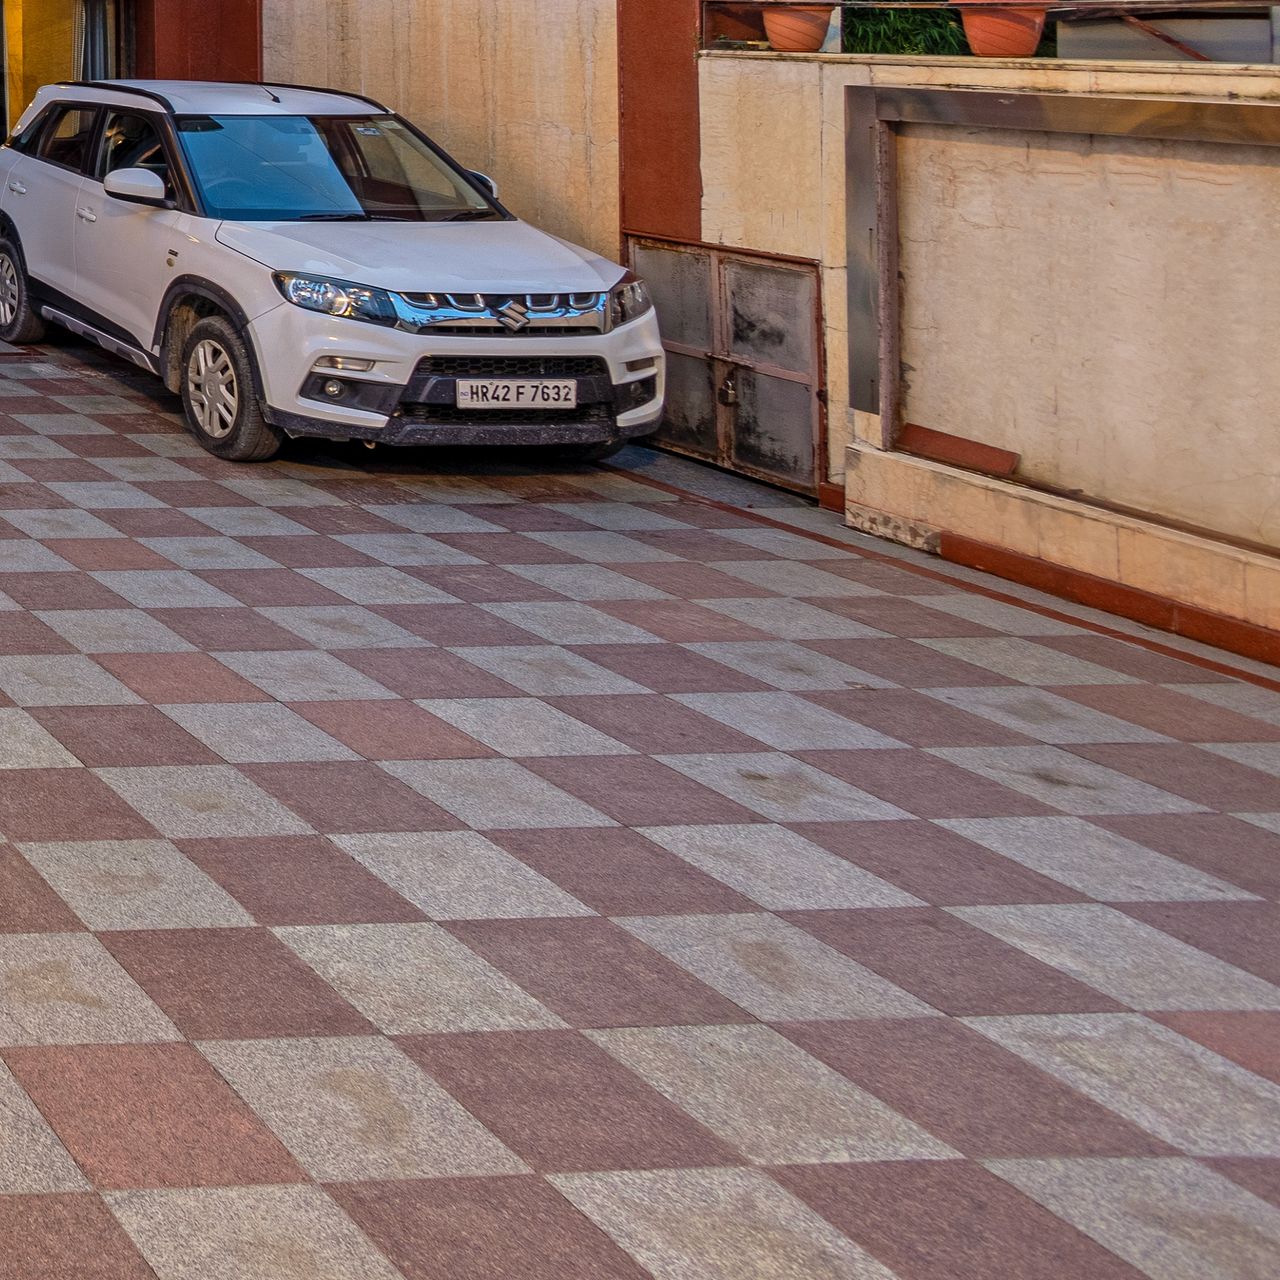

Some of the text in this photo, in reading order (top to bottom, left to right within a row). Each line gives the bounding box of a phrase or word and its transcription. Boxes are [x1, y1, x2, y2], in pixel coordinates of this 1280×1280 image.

[470, 384, 511, 402] HR42
[516, 385, 526, 401] F
[530, 385, 572, 402] 7632
